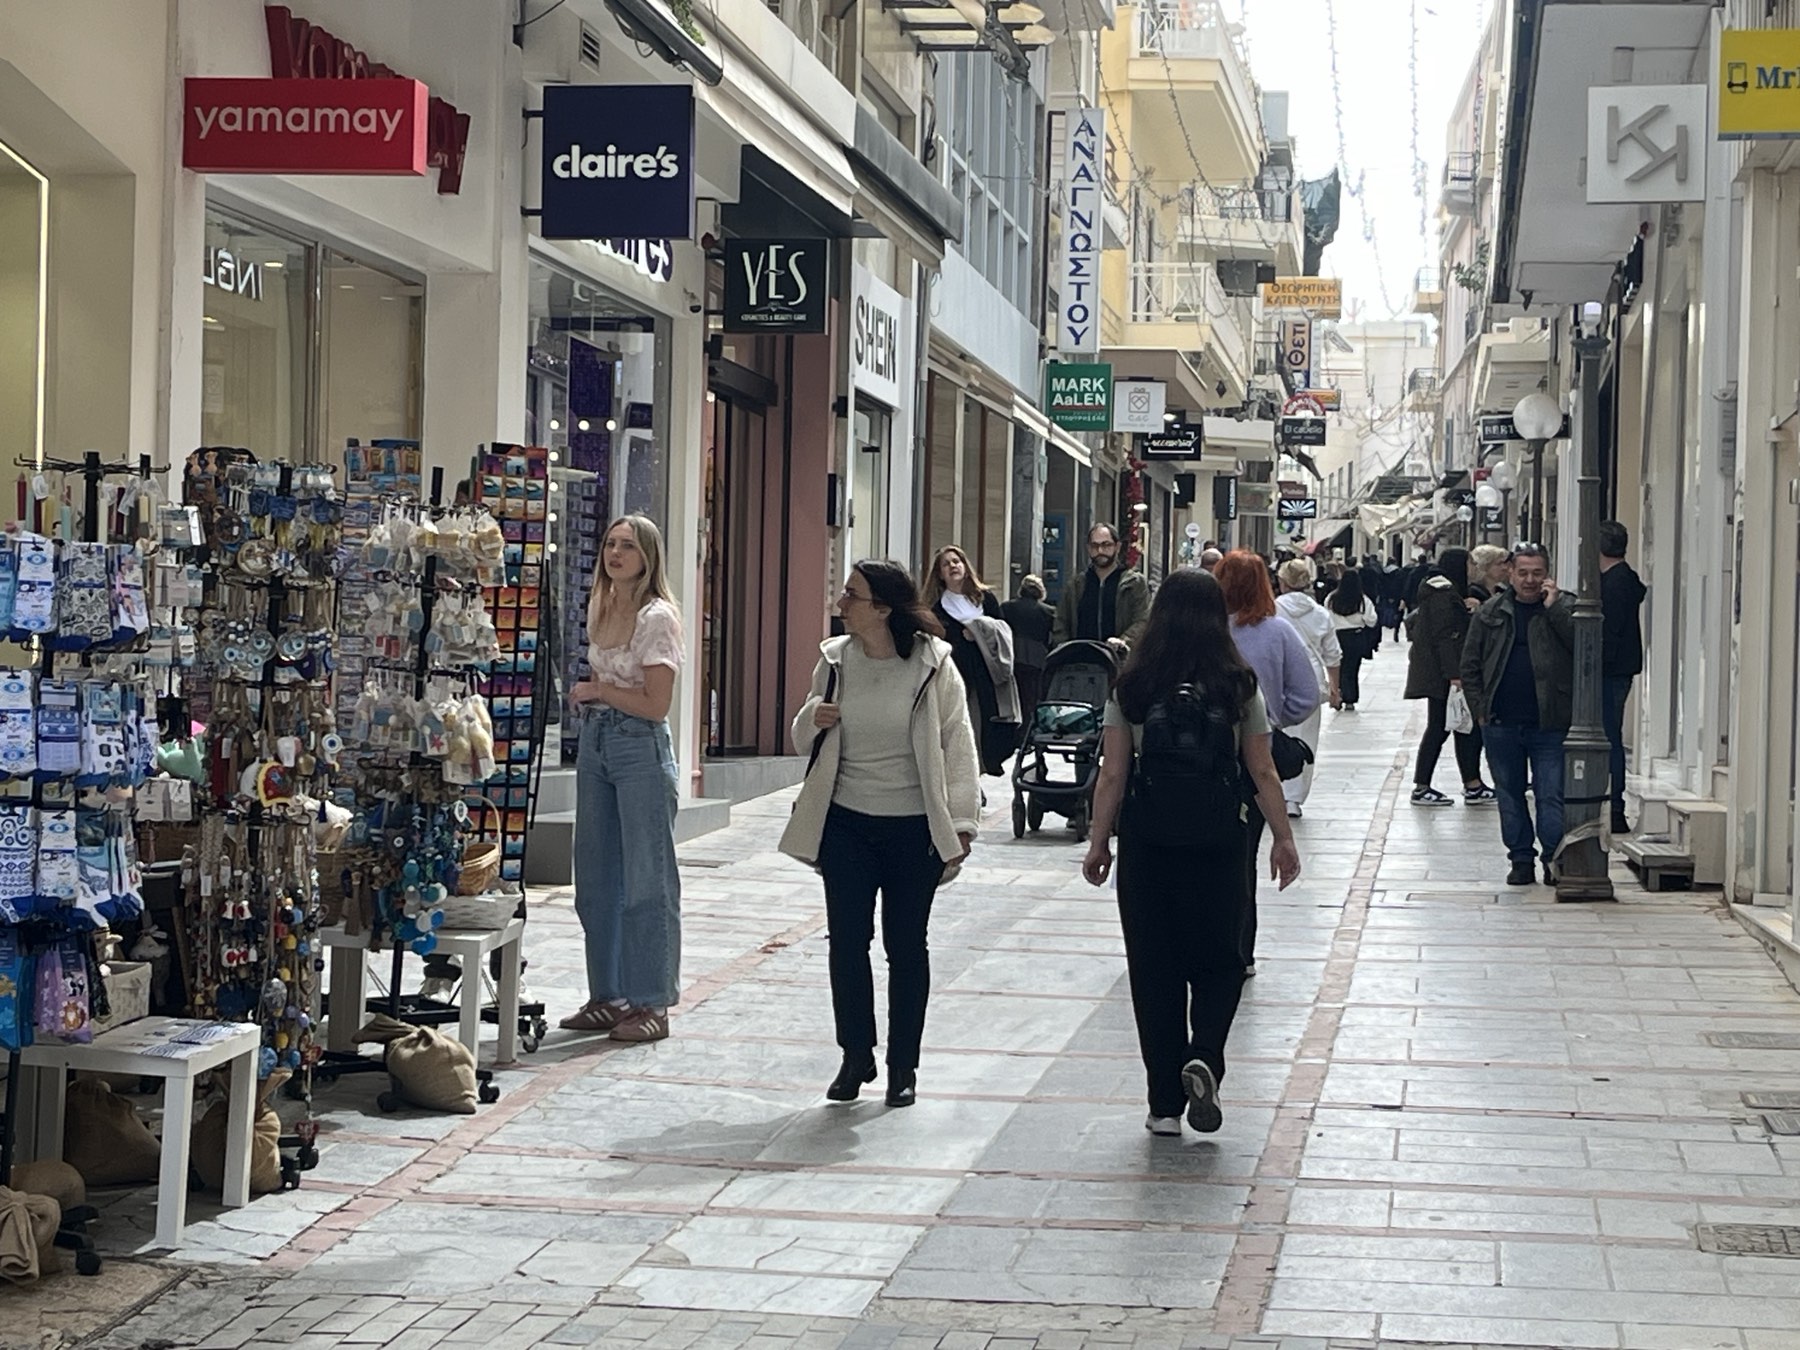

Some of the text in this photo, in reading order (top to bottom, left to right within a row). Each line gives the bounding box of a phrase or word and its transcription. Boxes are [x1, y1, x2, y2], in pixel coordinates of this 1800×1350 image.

[1755, 66, 1800, 89] Mr
[194, 106, 403, 141] yamamay
[553, 144, 679, 178] claire's
[1067, 119, 1096, 346] ΑΝΑΓΝΩΣΤΟΥ
[742, 245, 808, 306] YES
[1271, 283, 1336, 294] ΘΕΩΡΗΤΙΚΗ
[1266, 295, 1341, 305] ΚΑΤΕΥΘΥΝΣΗ
[855, 294, 898, 384] SHEIN
[1051, 378, 1105, 392] MARK
[1052, 393, 1106, 406] AaLEN
